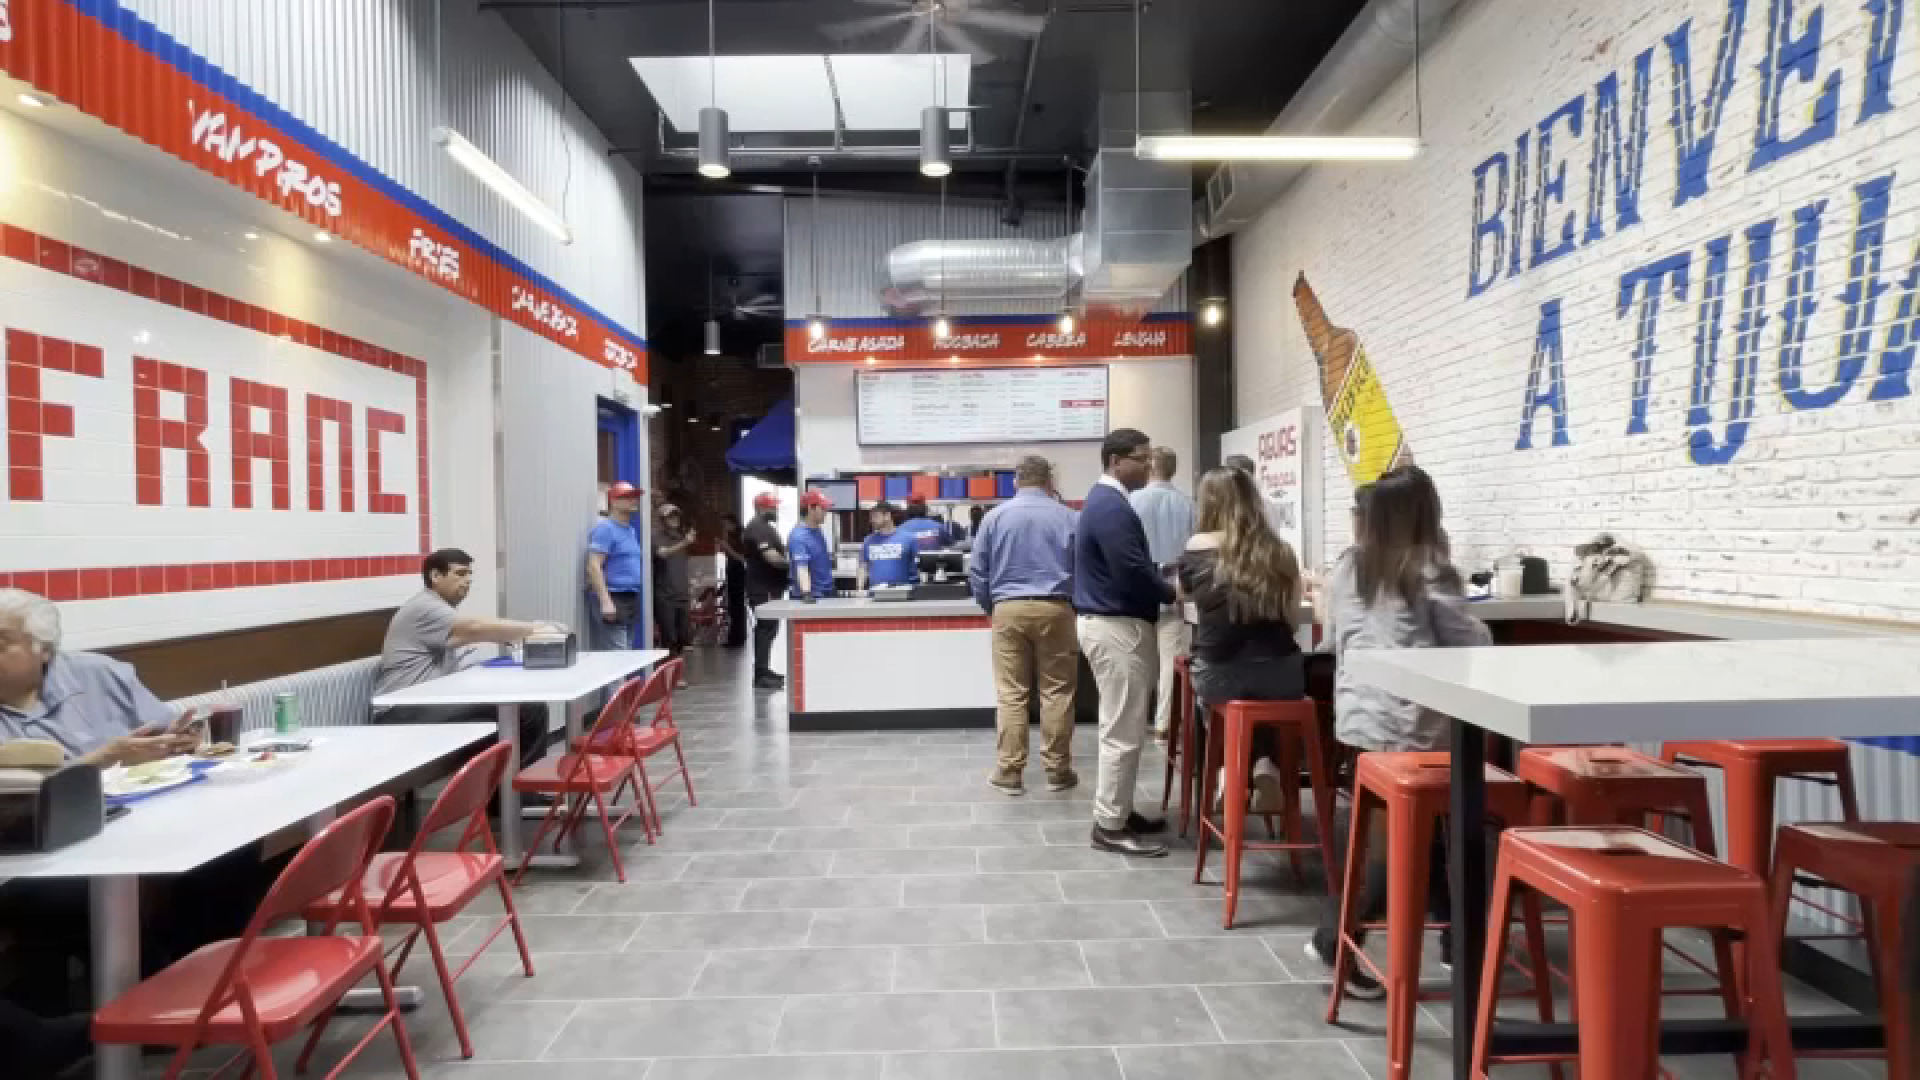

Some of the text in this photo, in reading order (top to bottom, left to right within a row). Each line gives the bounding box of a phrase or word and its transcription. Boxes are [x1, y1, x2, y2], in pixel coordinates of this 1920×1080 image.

[1466, 0, 1904, 299] BIENVE
[807, 335, 857, 353] CARNE
[858, 335, 905, 353] ASADA
[1515, 298, 1571, 450] A
[4, 327, 408, 516] FRANC
[1258, 424, 1297, 462] AGUAS
